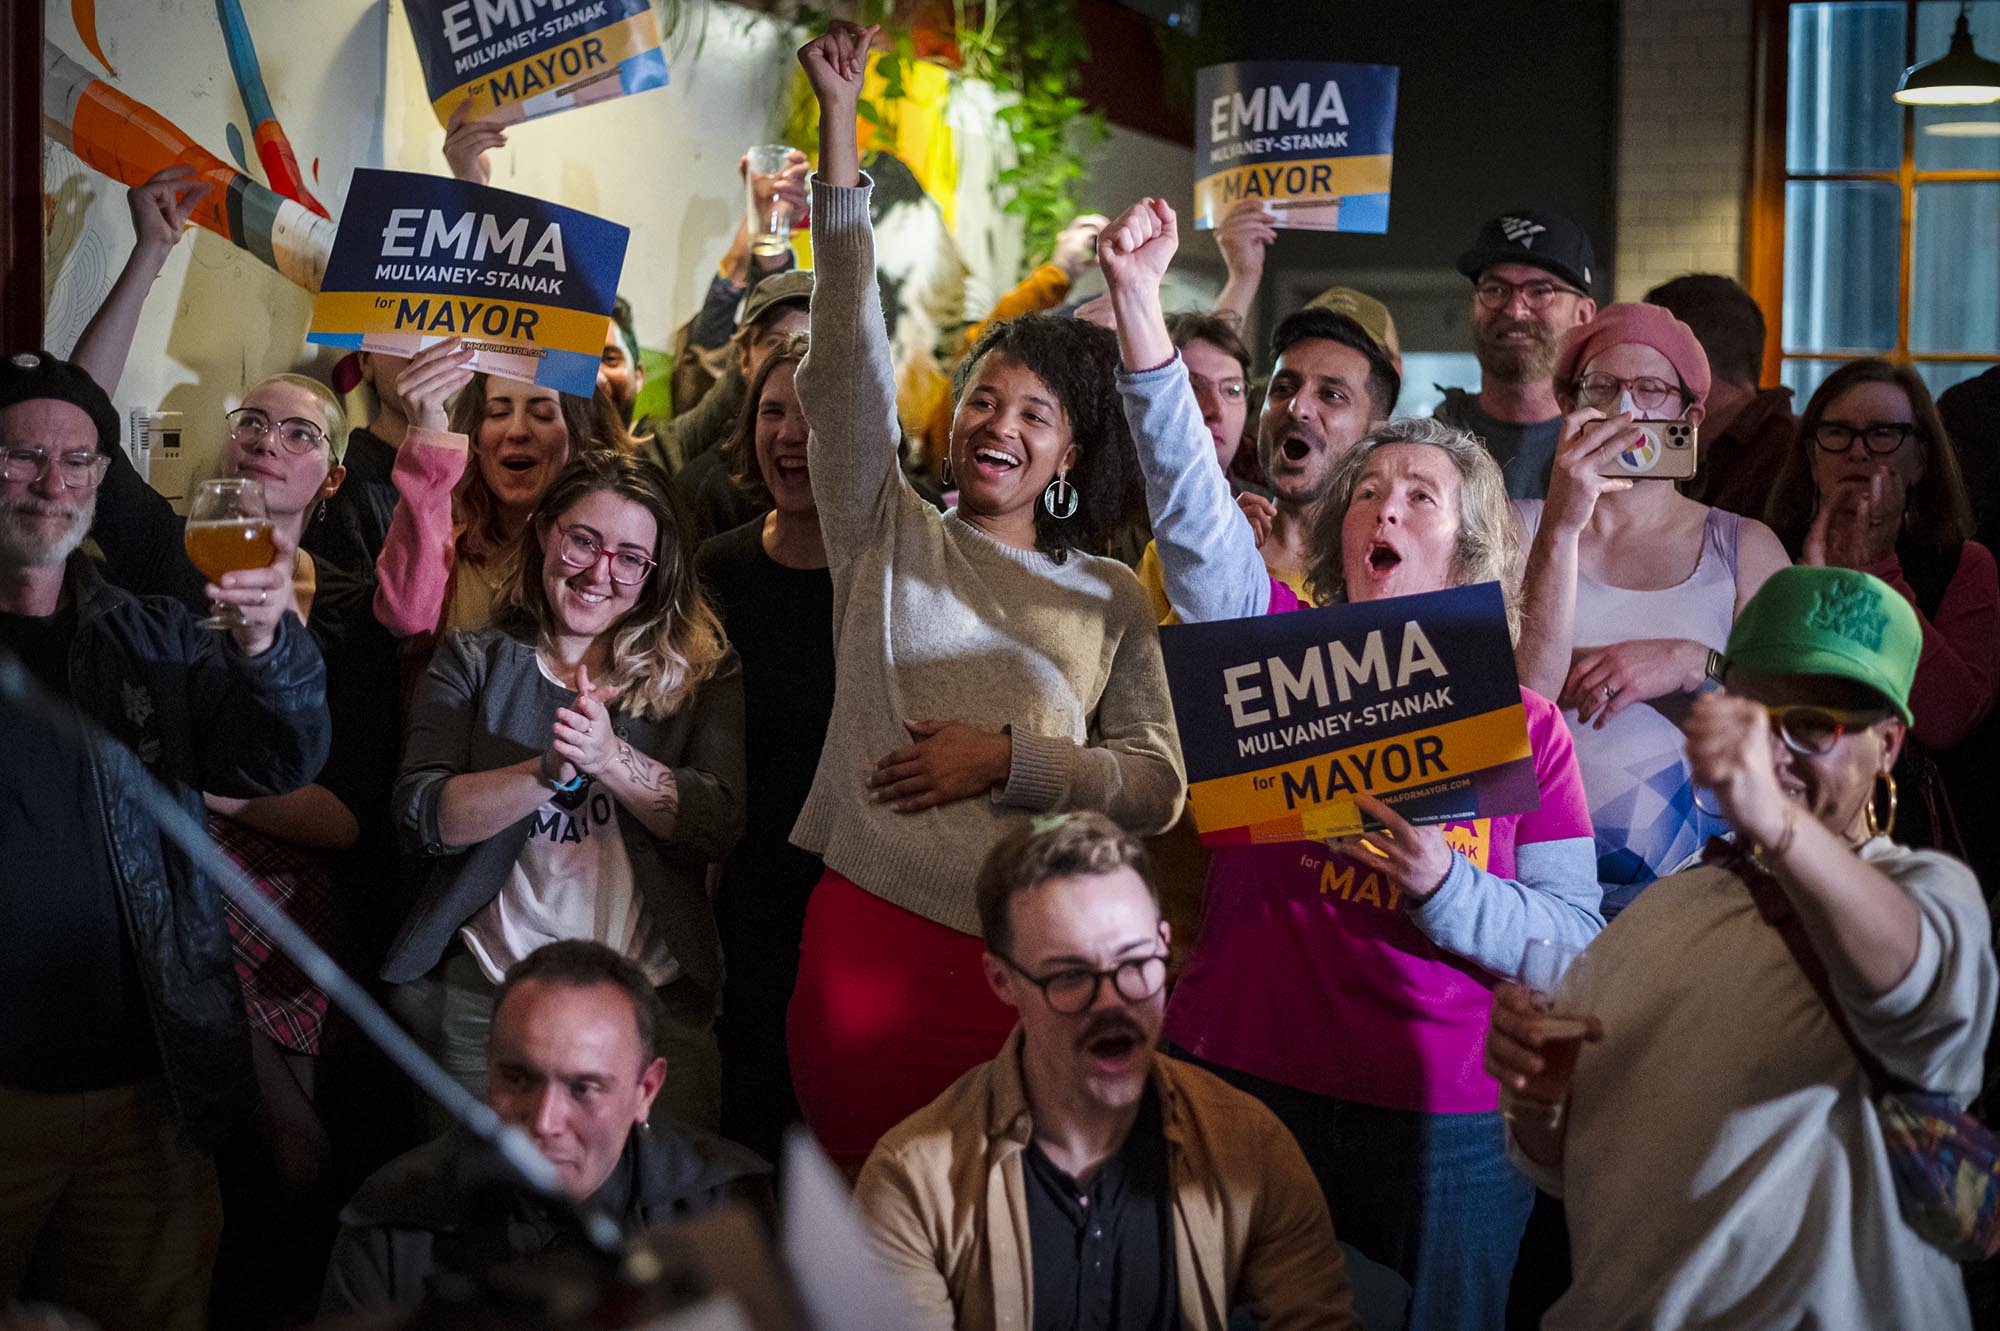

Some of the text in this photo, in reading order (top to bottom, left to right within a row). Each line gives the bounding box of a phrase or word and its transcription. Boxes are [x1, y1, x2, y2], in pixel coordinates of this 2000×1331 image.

[442, 0, 577, 53] EMM
[454, 2, 608, 75] MULVANEY-STANAK
[468, 82, 485, 97] for
[489, 37, 607, 106] MAYOR
[1210, 80, 1349, 143] EMMA
[1224, 165, 1331, 203] MAYOR
[381, 208, 567, 272] EMMA
[375, 264, 563, 295] MULVANEY-STANAK
[374, 297, 540, 341] for MAYOR
[1224, 620, 1448, 728] EMMA
[1237, 686, 1454, 758] MULVANEY-STANAK
[1252, 735, 1449, 810] for MAYOR
[1383, 778, 1471, 804] MAFORMAYOR.COM
[1300, 854, 1321, 869] for
